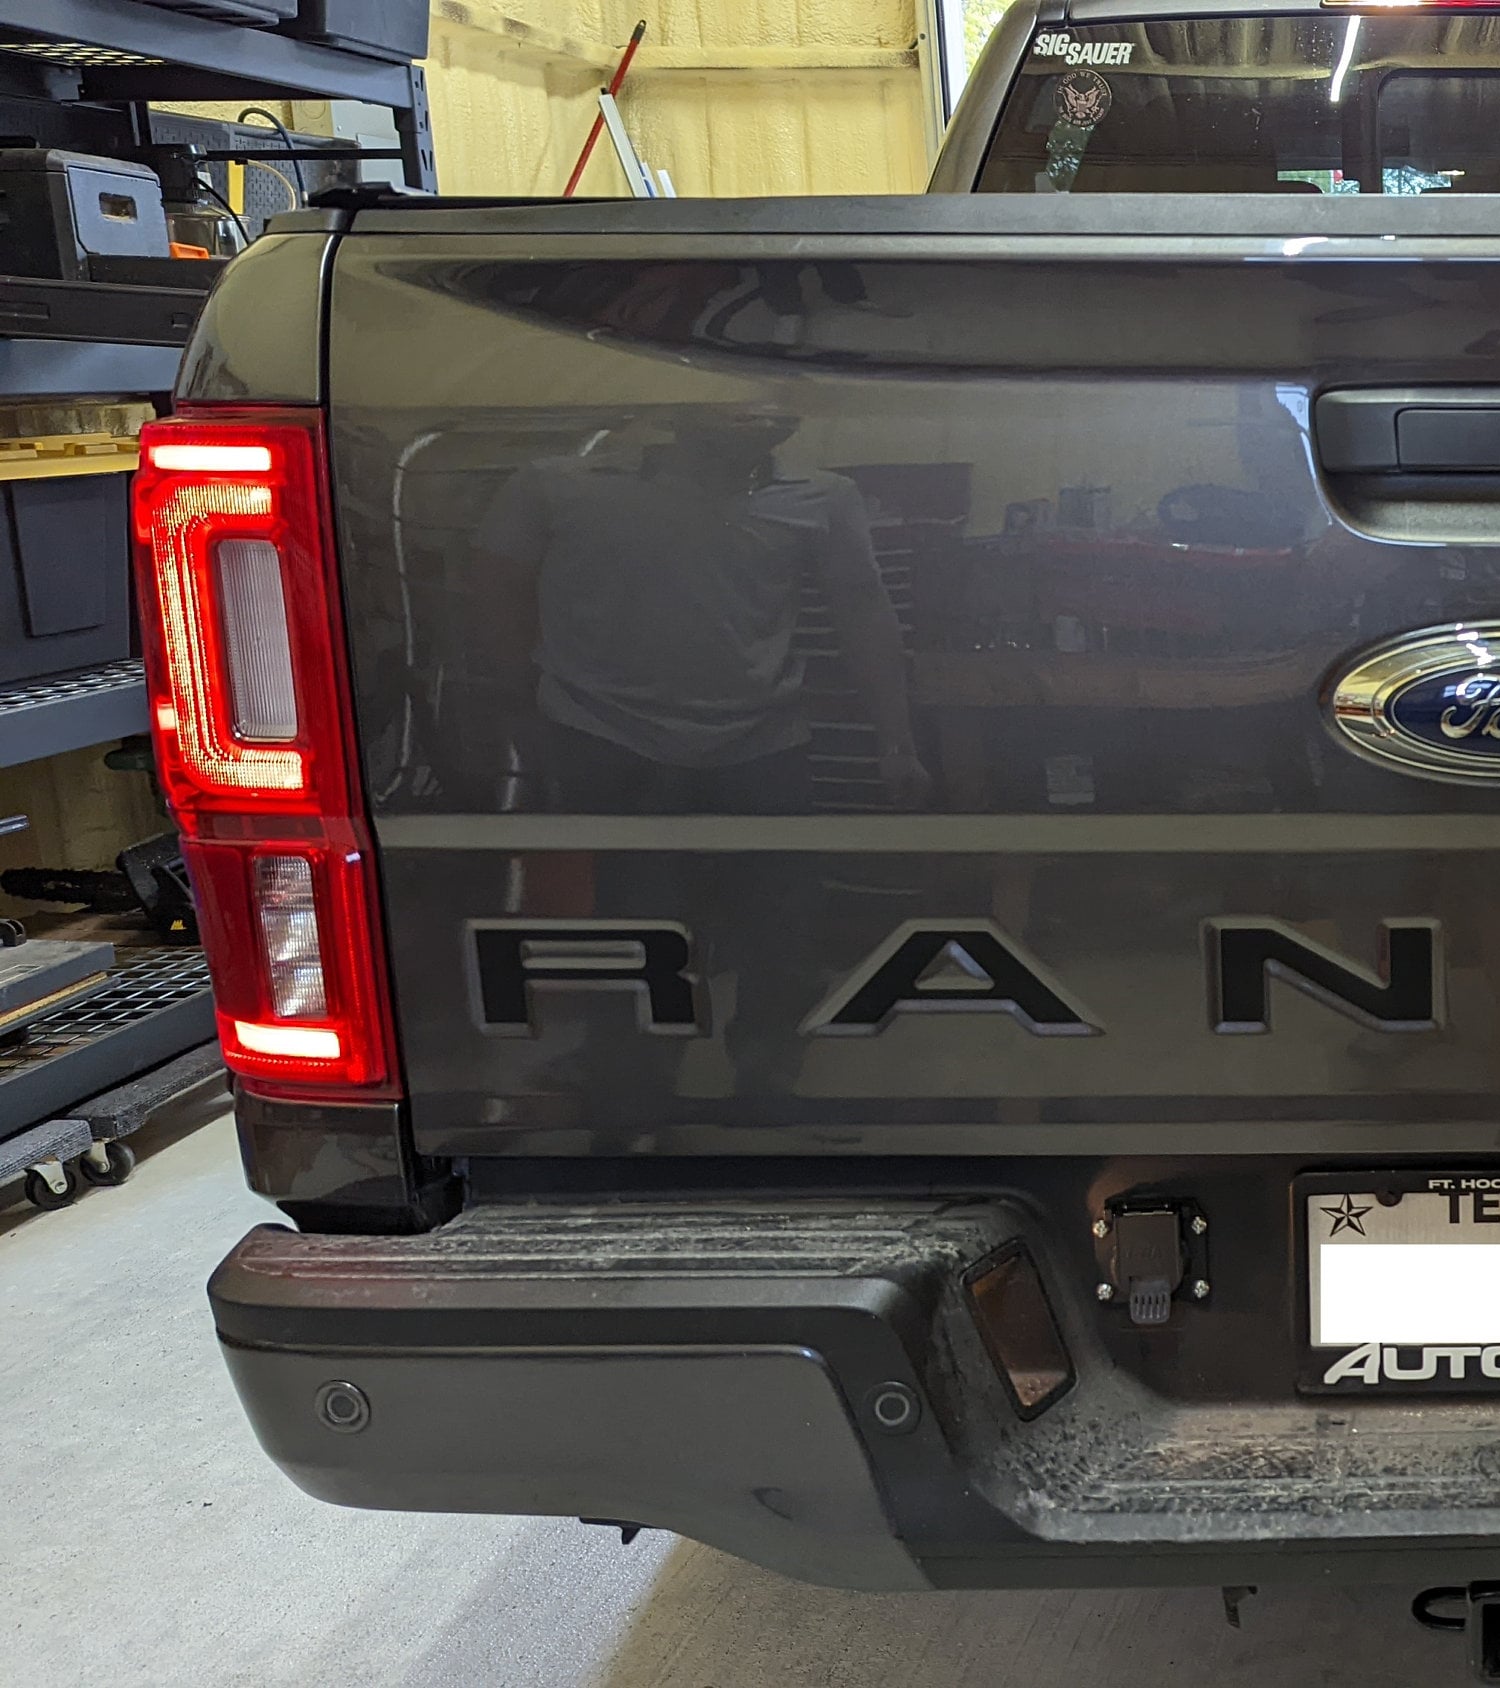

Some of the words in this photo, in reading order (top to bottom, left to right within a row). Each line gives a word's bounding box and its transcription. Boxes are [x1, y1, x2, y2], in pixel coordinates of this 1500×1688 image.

[1033, 33, 1070, 56] SIG
[1064, 42, 1132, 65] SAUER
[1428, 1179, 1456, 1189] FT.
